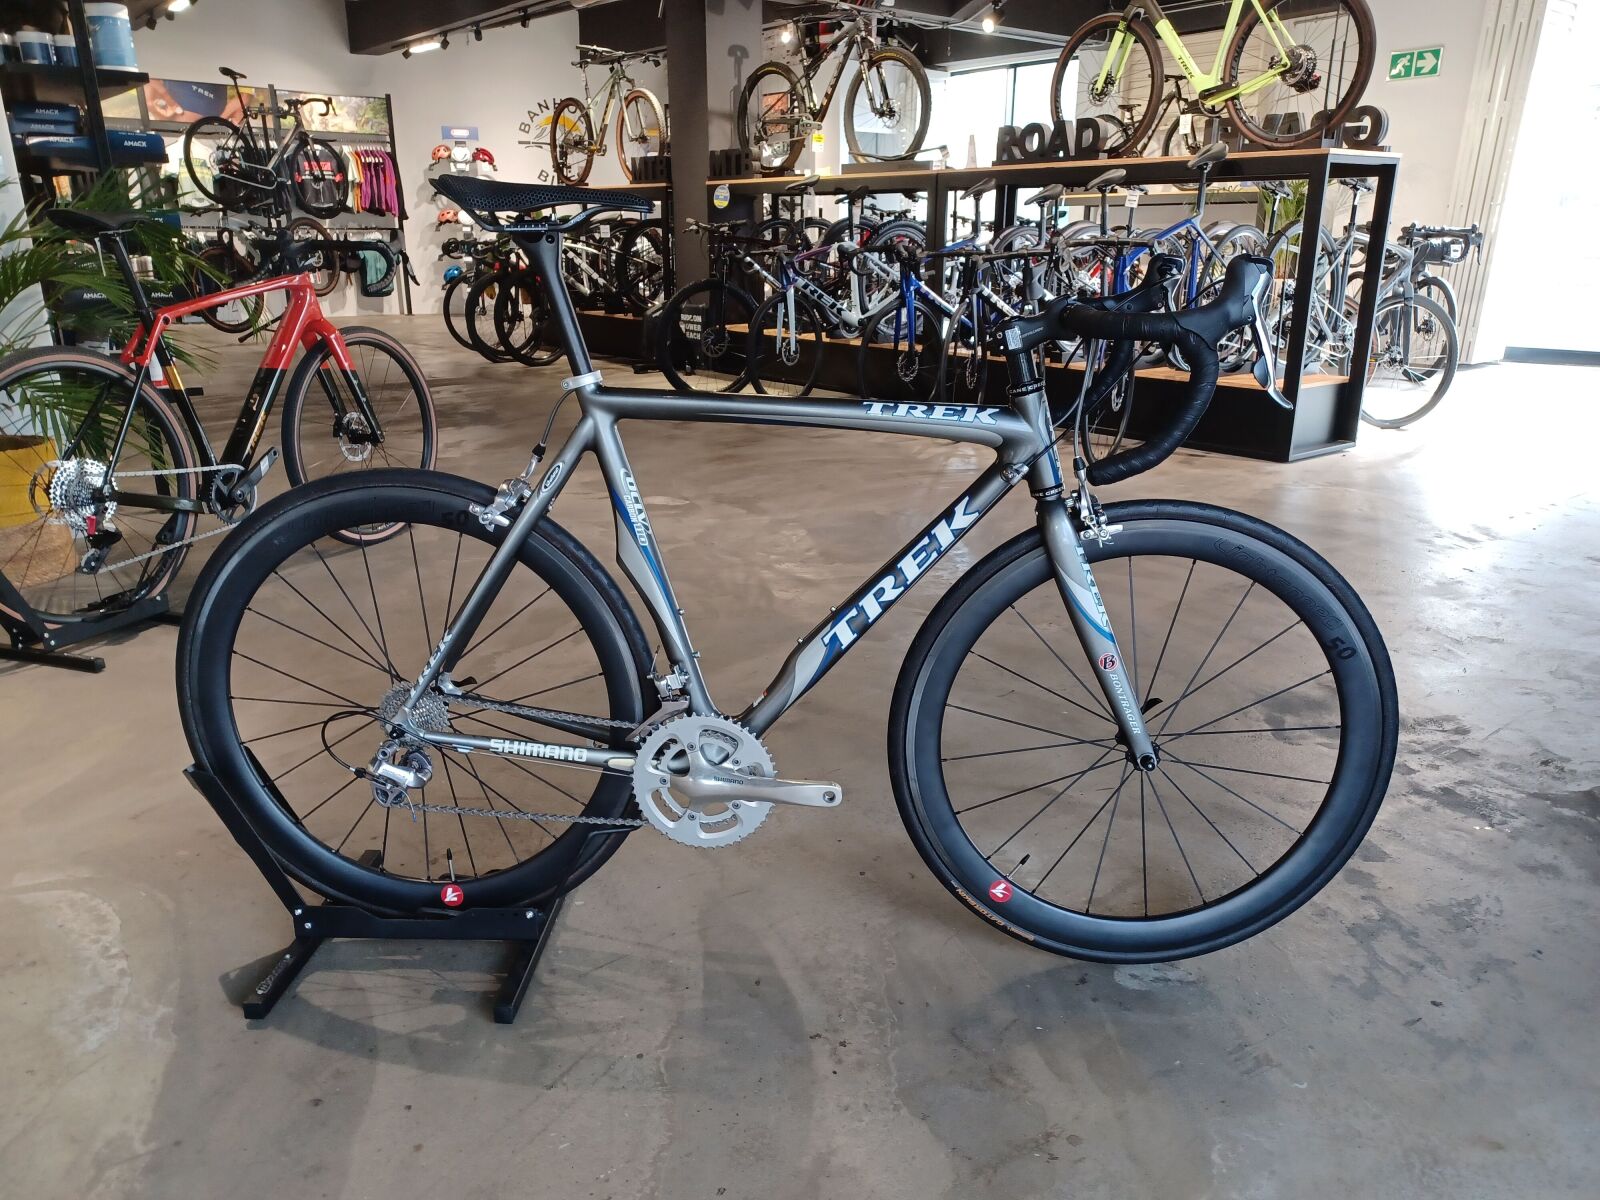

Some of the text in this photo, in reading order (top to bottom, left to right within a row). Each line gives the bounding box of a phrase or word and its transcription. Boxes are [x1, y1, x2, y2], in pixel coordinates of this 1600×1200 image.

[1178, 55, 1195, 78] TREK
[123, 139, 147, 148] AMACX
[997, 118, 1102, 162] ROAD
[631, 155, 668, 184] MTB
[709, 148, 752, 178] MTB
[862, 401, 1000, 425] TREK
[623, 494, 638, 523] CARBON
[821, 495, 980, 650] TREK
[1327, 636, 1357, 660] 50
[1109, 673, 1141, 735] BONTRAGER
[489, 738, 588, 763] SHIMANO
